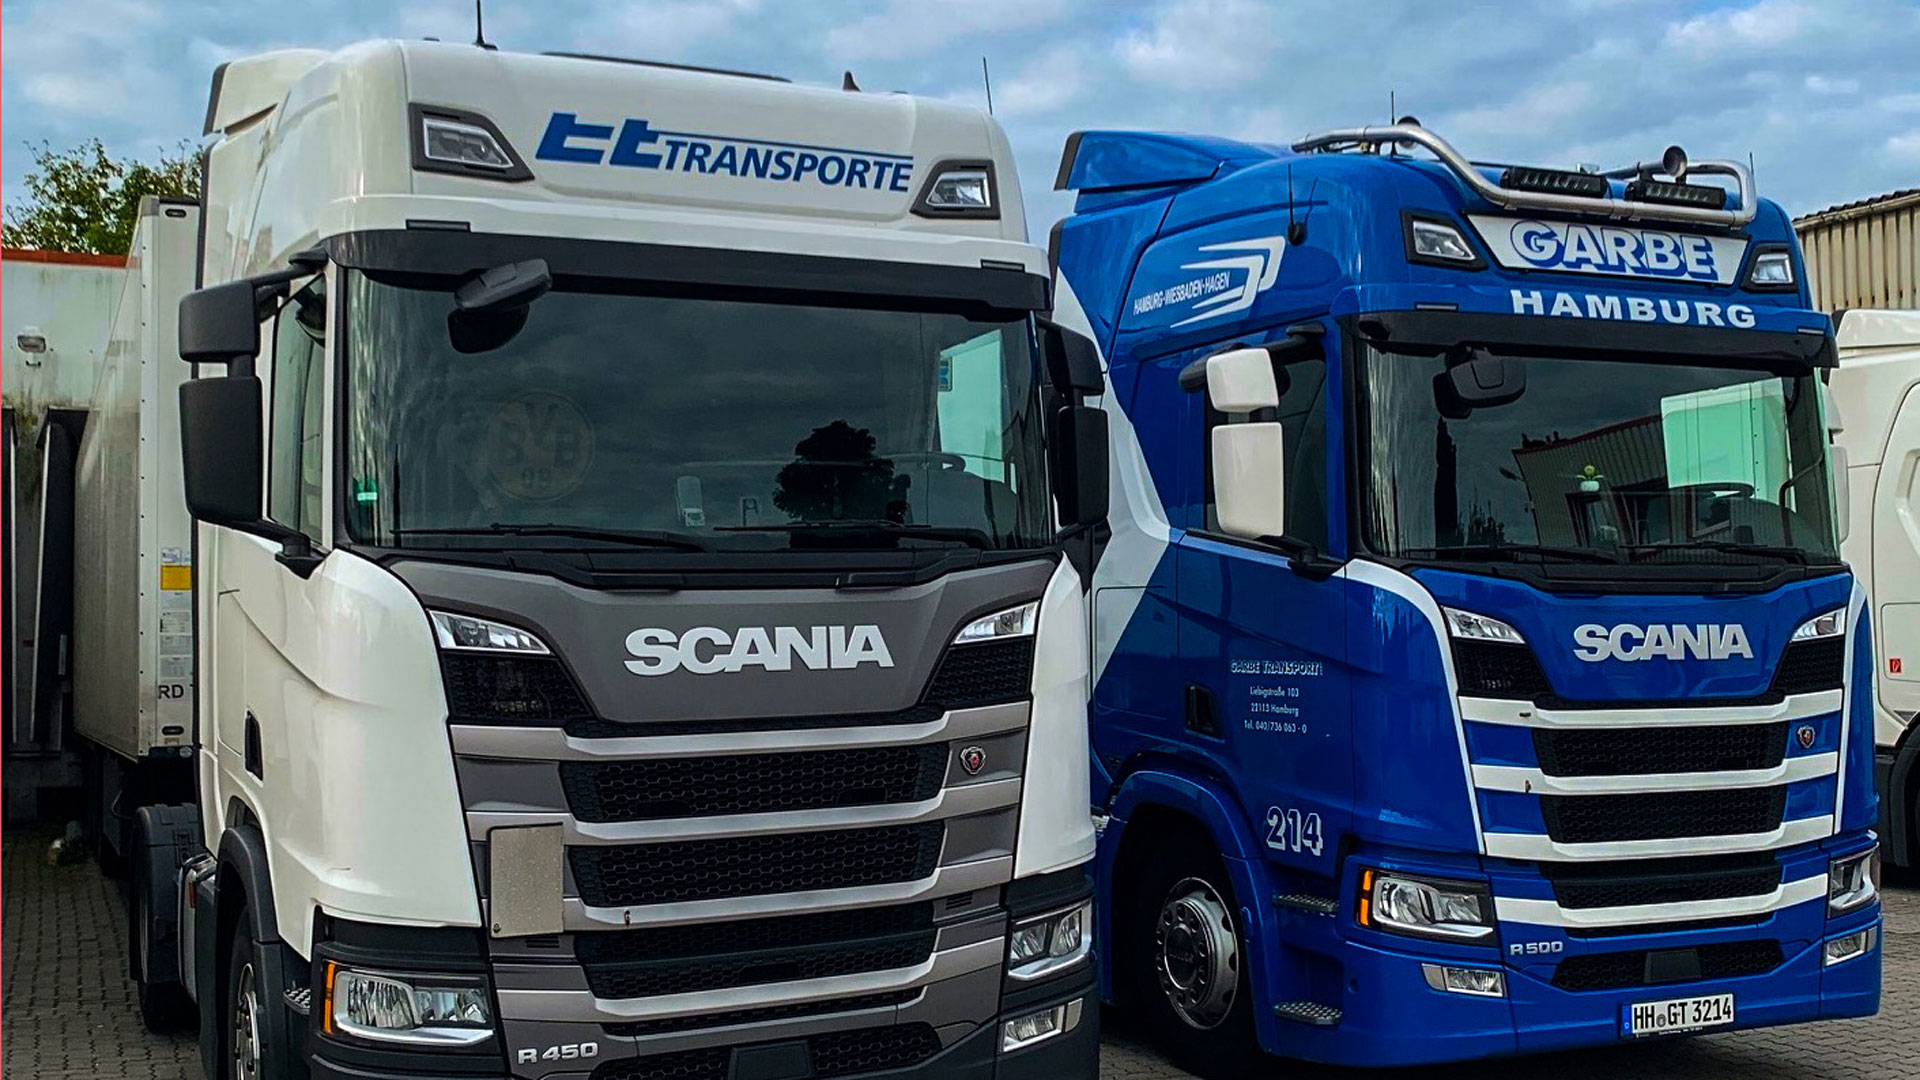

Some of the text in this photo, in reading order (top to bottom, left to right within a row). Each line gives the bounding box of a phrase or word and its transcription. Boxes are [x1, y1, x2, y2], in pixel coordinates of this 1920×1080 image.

[664, 138, 914, 193] TRANSPORTE
[1510, 219, 1719, 281] GARBE
[1510, 289, 1756, 328] HAMBURG
[624, 625, 895, 677] SCANIA
[1573, 623, 1755, 662] SCANIA
[1231, 660, 1261, 674] GARBE
[1262, 660, 1320, 676] TRANSPORT
[1287, 687, 1299, 697] 103
[1251, 703, 1299, 718] 22113 Hamburg
[1266, 806, 1324, 857] 214
[1510, 940, 1564, 956] R 500
[1633, 1004, 1656, 1030] HH
[1667, 1001, 1688, 1026] GT
[1692, 996, 1732, 1023] 3214
[517, 1042, 599, 1064] R 450
